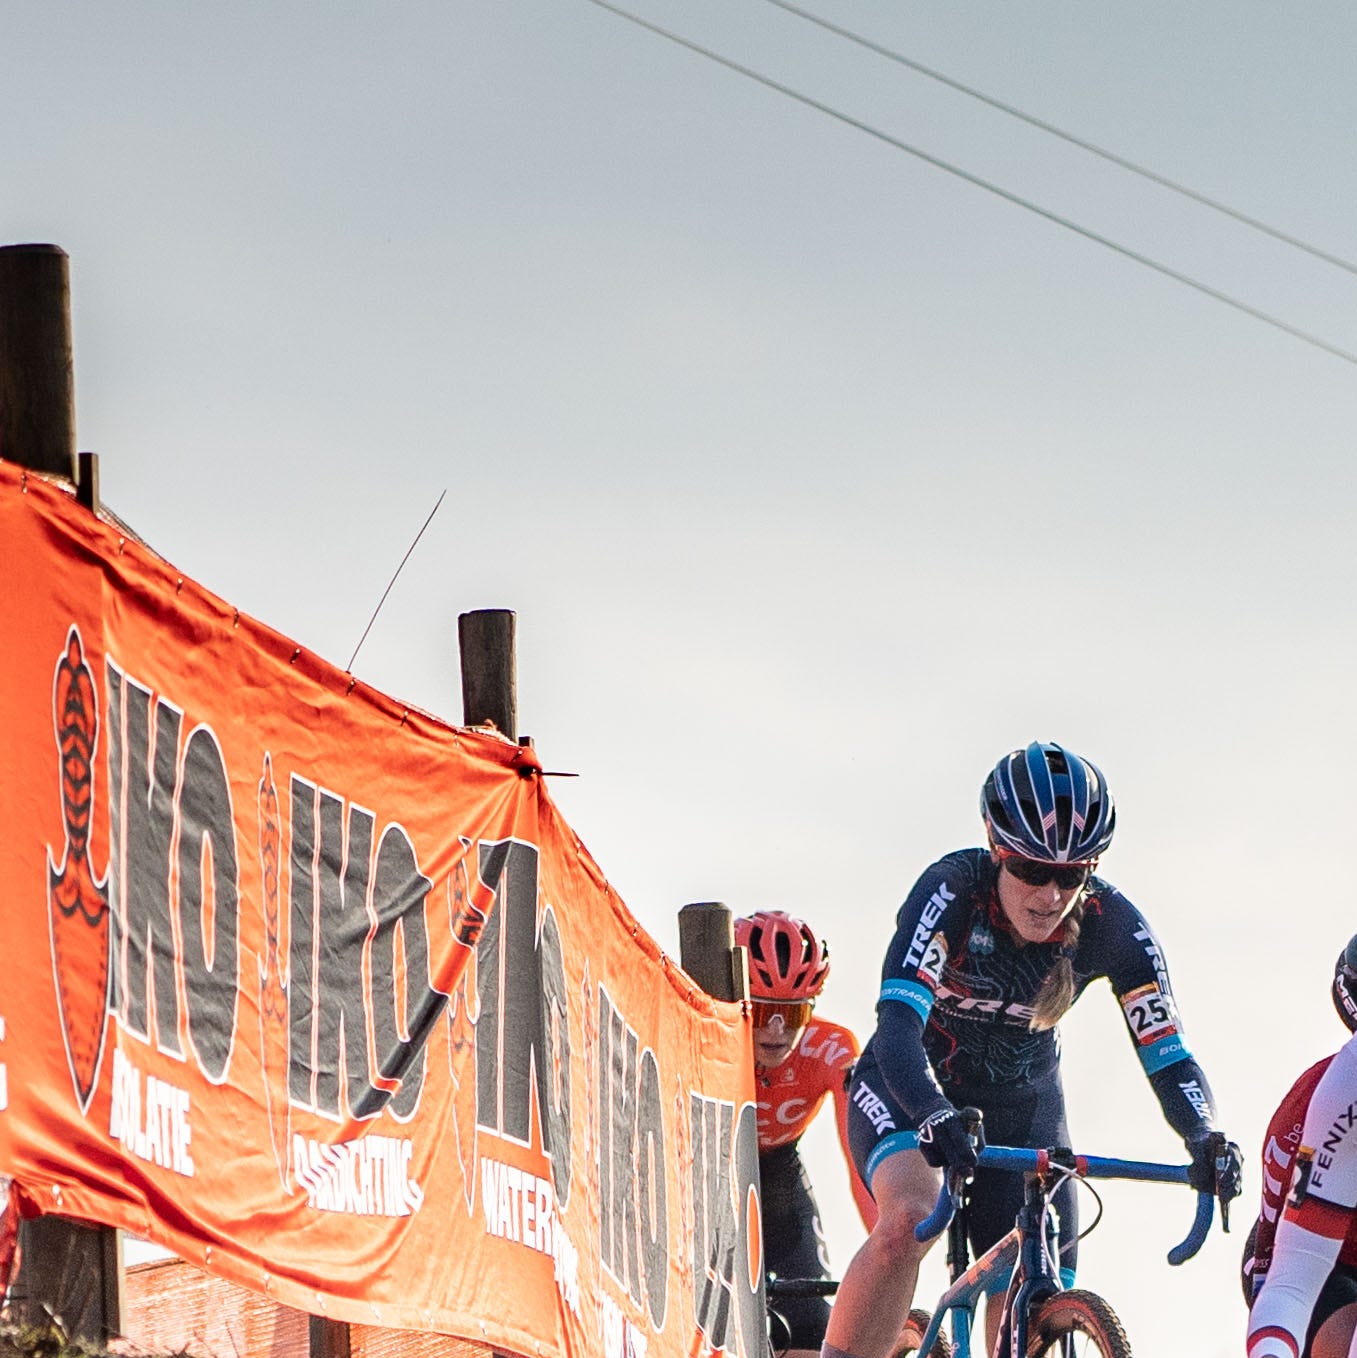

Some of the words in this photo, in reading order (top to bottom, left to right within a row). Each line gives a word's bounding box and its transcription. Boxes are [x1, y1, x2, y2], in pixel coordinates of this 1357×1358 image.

[902, 882, 956, 968] TREK
[935, 984, 1038, 1020] TRE
[1130, 999, 1168, 1033] 25
[799, 1026, 850, 1066] Liv
[109, 1048, 194, 1178] ISOLATIE
[853, 1080, 896, 1136] TREK
